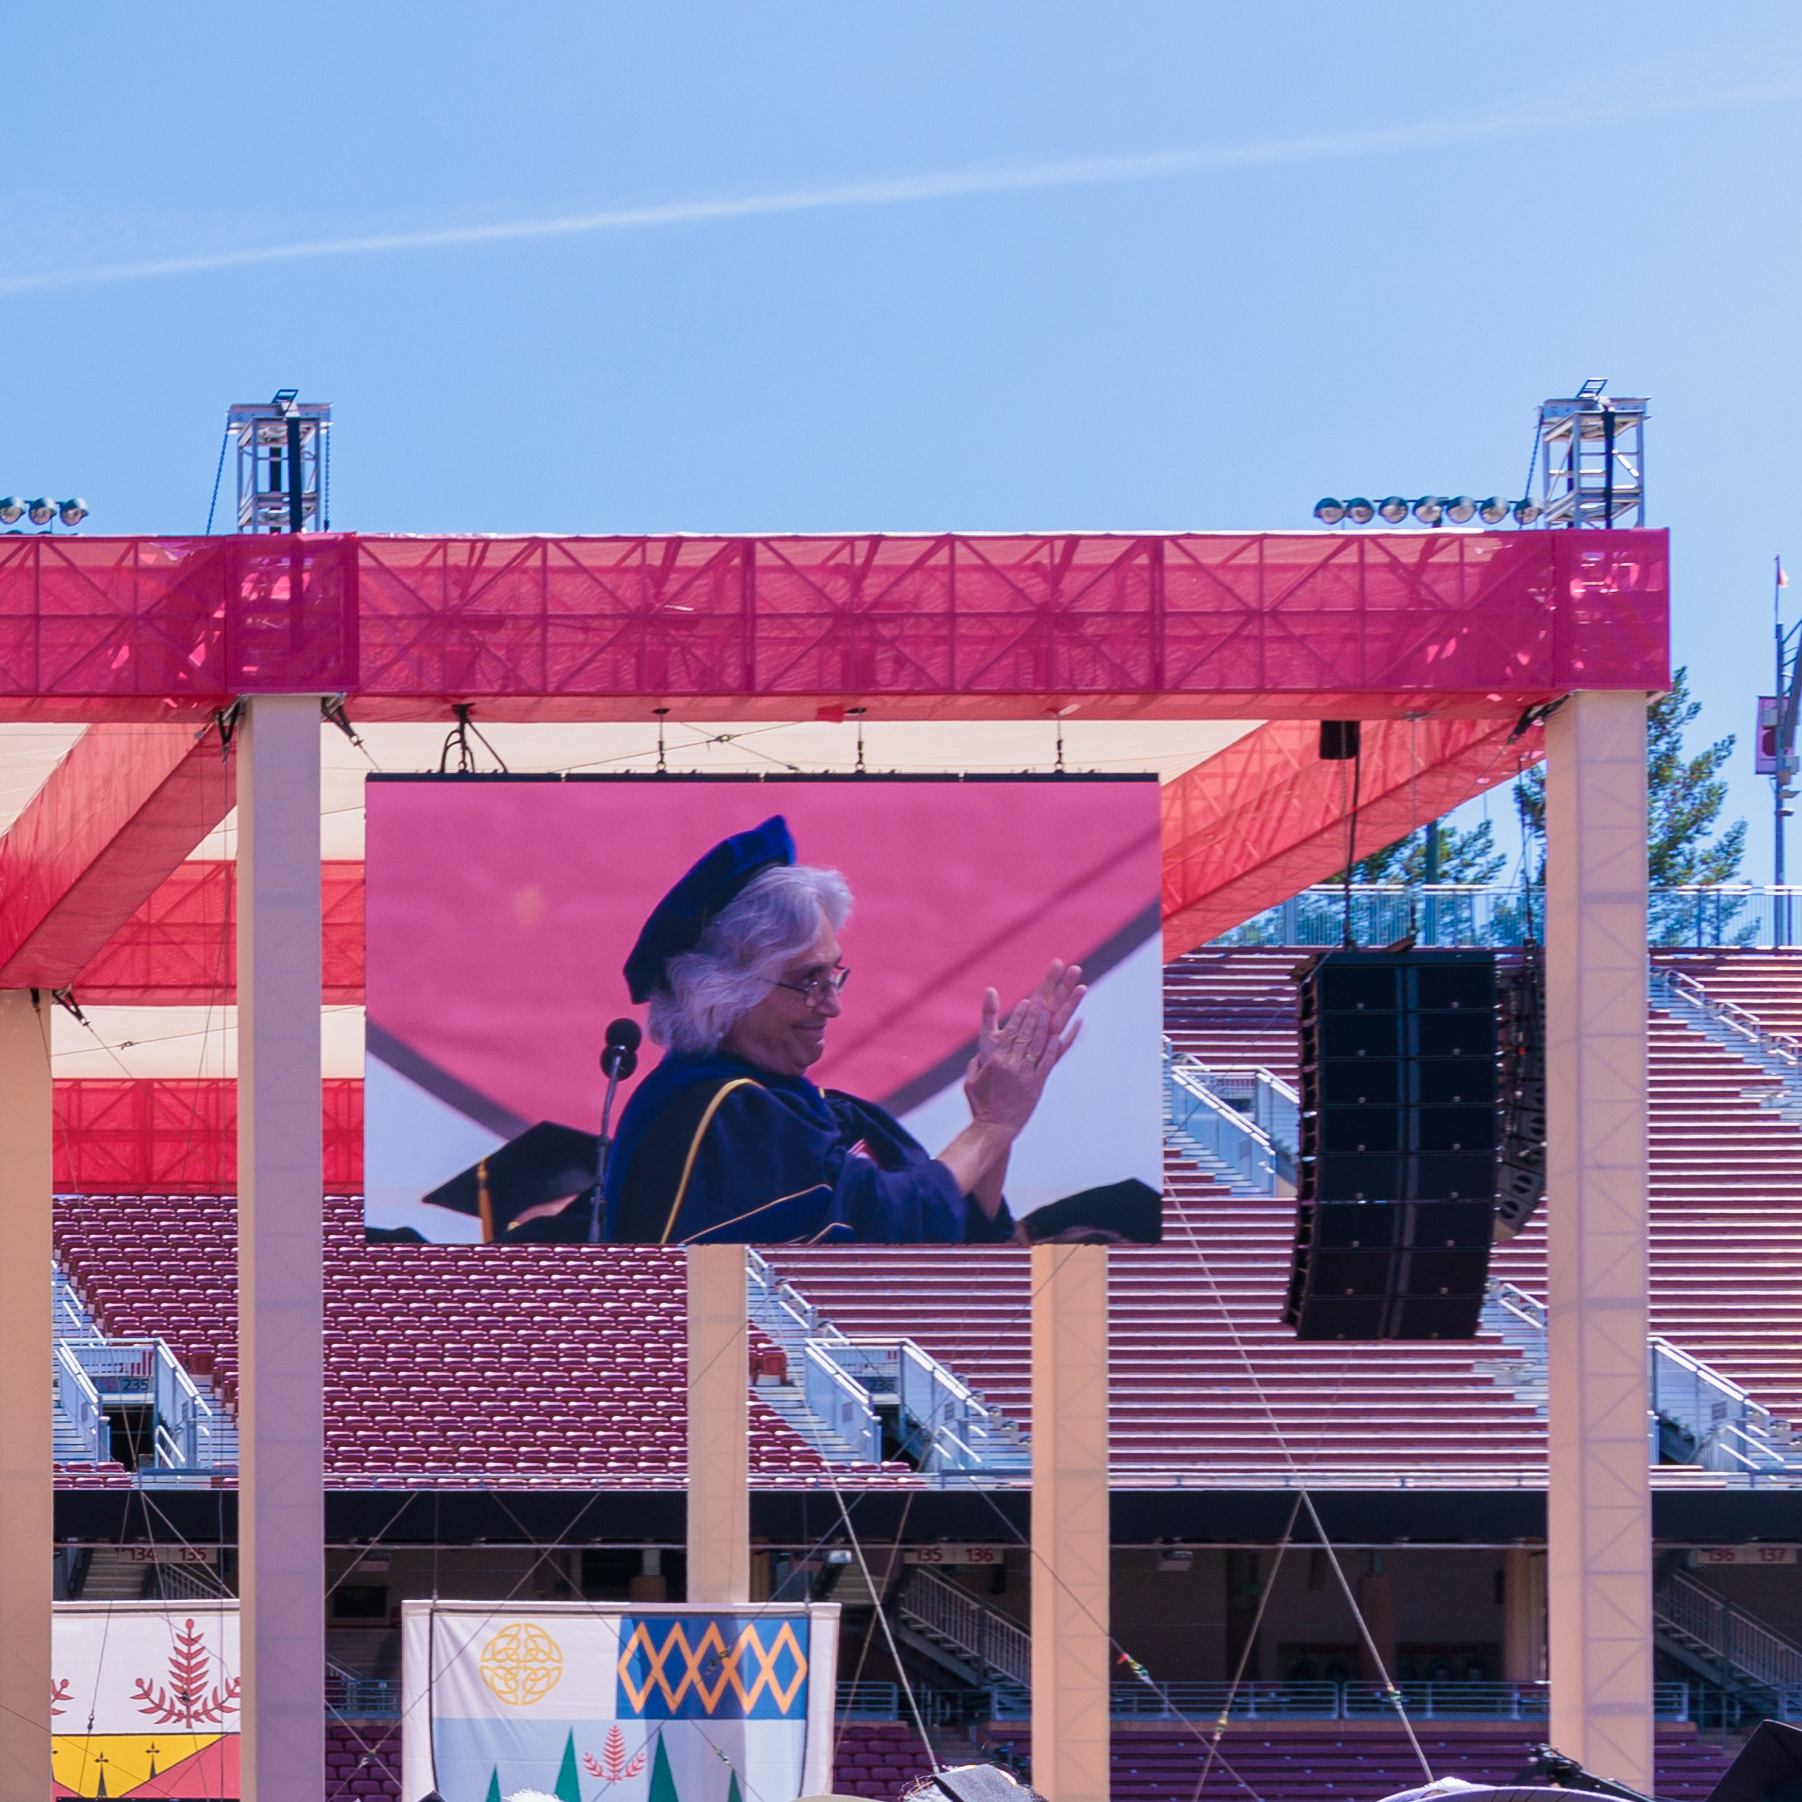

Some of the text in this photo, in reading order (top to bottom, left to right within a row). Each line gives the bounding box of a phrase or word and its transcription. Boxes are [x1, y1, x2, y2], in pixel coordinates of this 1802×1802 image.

[123, 1378, 149, 1391] 235
[869, 1379, 896, 1392] 236
[128, 1546, 207, 1562] 134 135
[917, 1547, 995, 1562] 135 136
